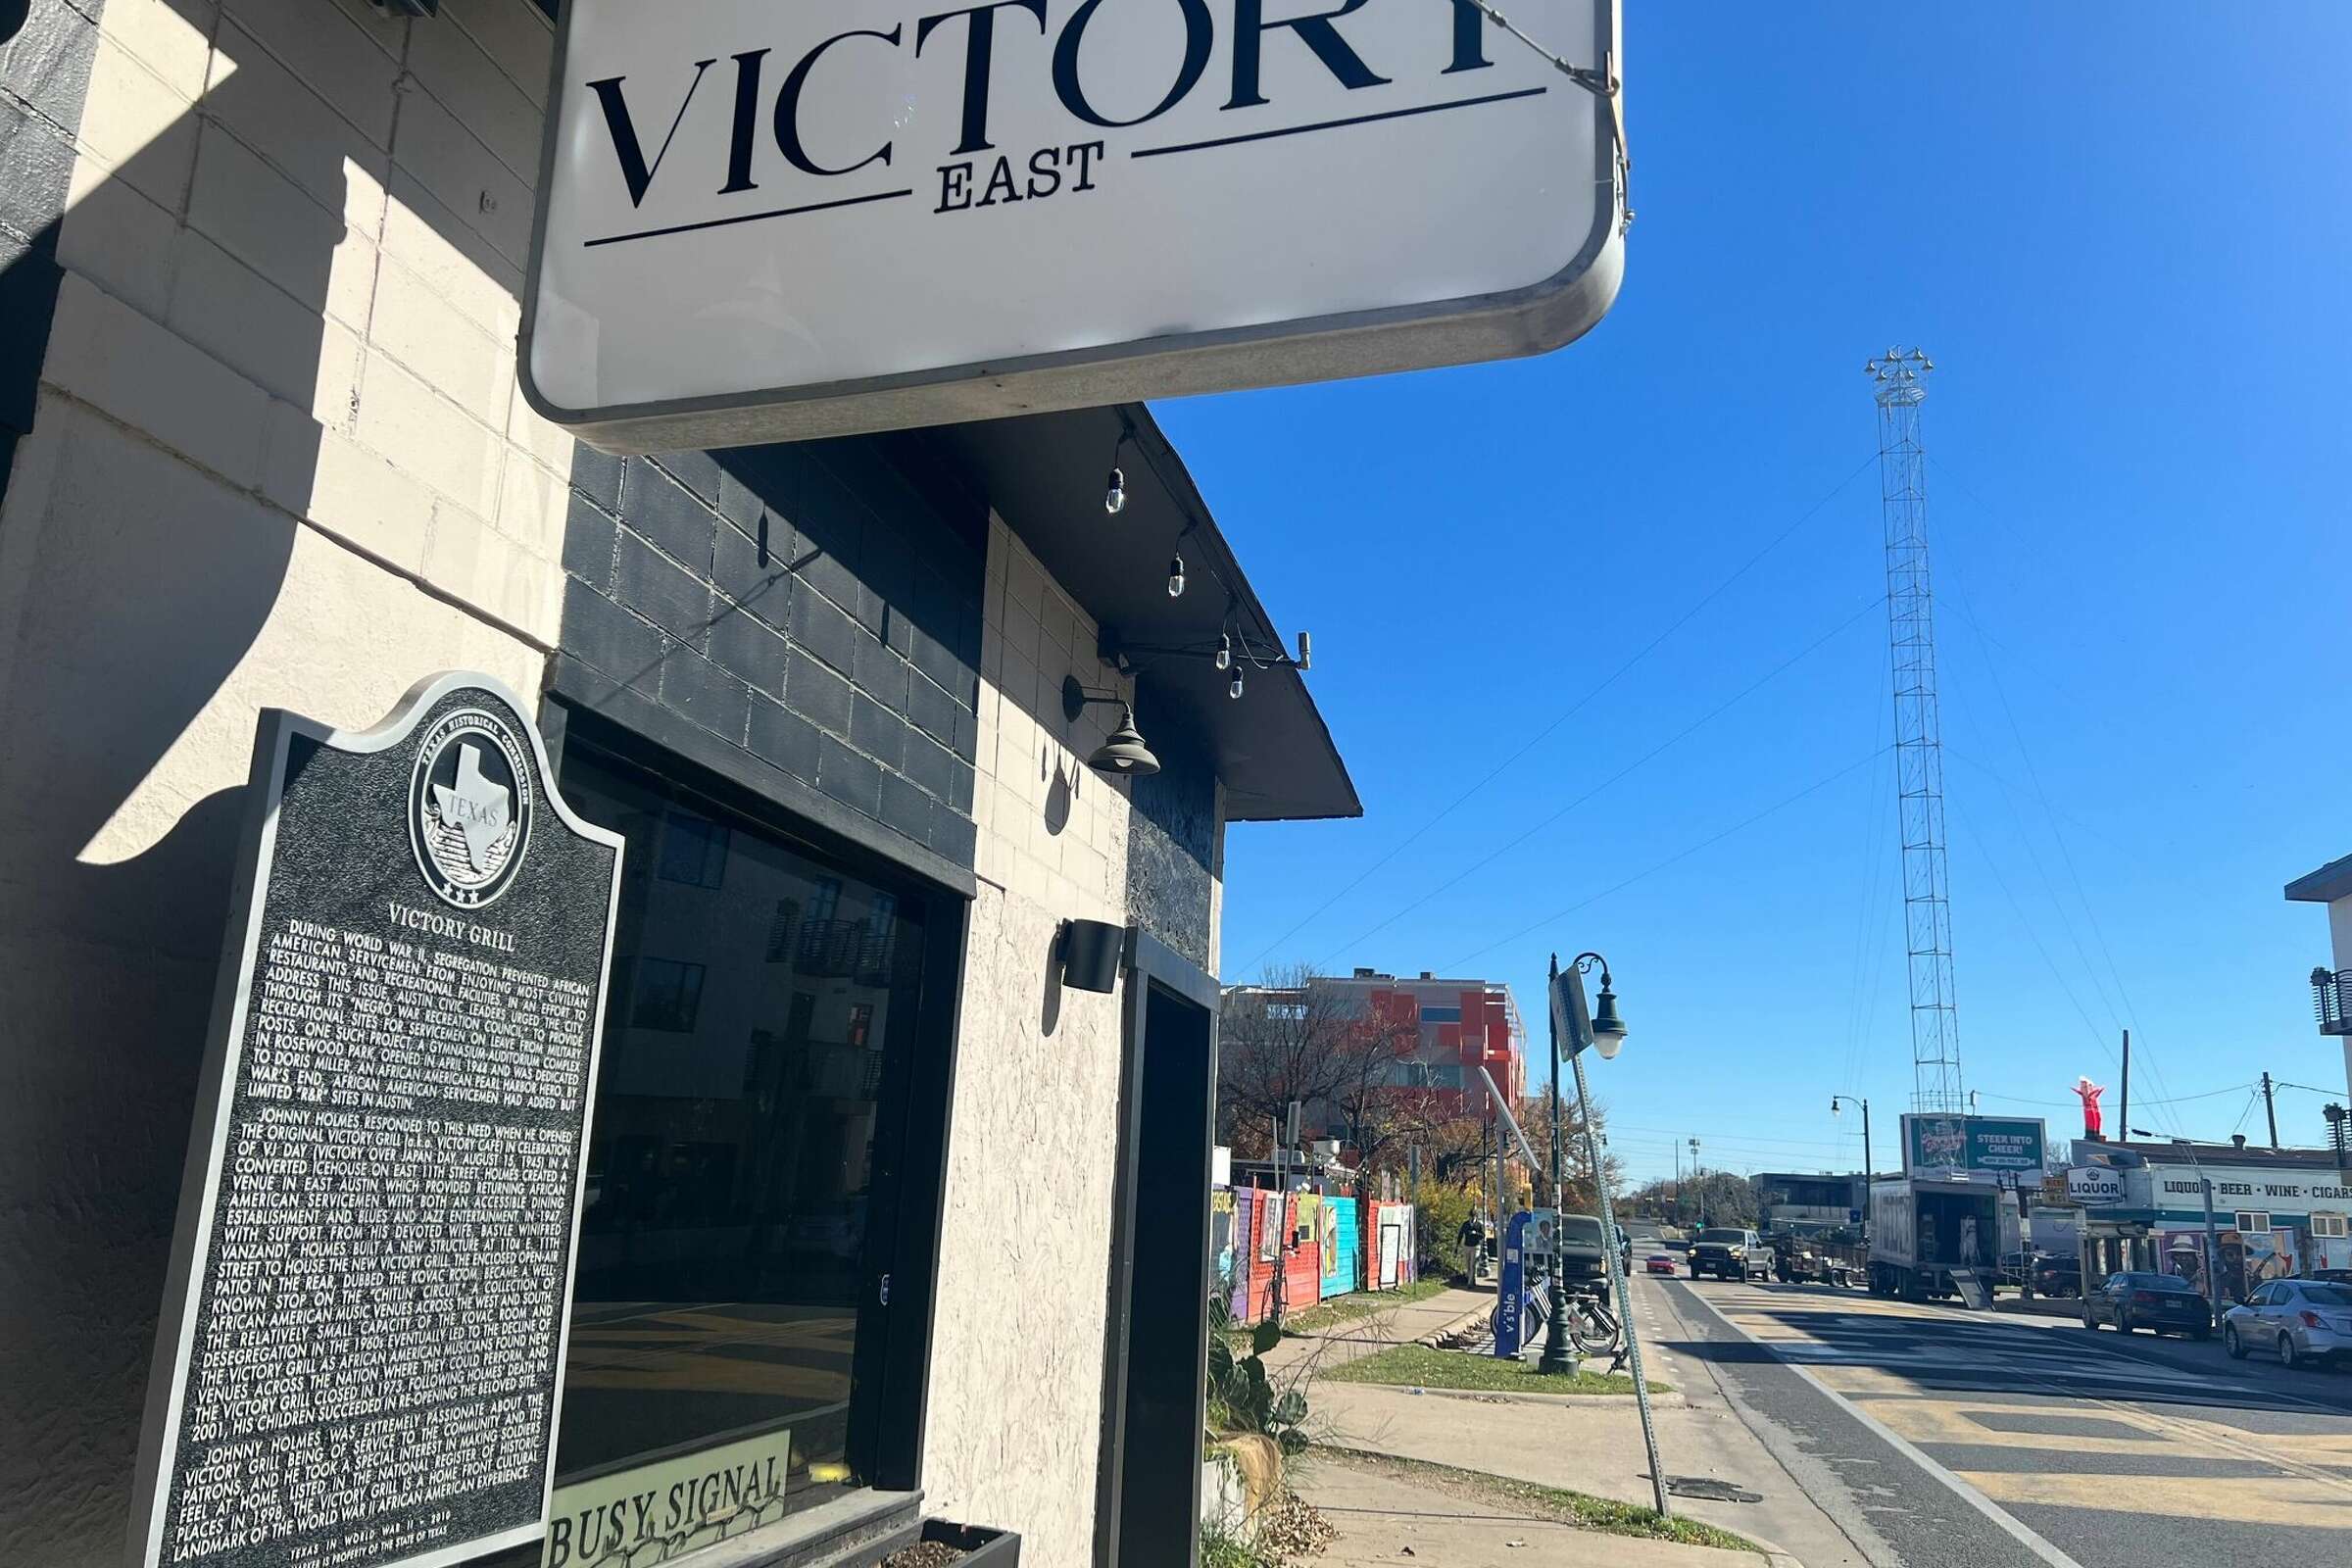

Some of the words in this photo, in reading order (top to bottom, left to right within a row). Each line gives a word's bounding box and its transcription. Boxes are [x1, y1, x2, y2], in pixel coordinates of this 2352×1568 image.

[933, 141, 1104, 216] EAST
[421, 728, 447, 765] TEXAS
[448, 714, 499, 736] HISTORICAL
[501, 734, 529, 806] COMMISSION
[448, 795, 500, 828] TEXAS
[287, 920, 337, 945] DURING
[341, 932, 383, 954] WORLD
[387, 942, 413, 959] WAR
[416, 948, 430, 965] II,
[432, 951, 498, 977] SEGREGATION
[501, 965, 549, 987] PREVENTED
[552, 976, 590, 995] AFRICAN
[389, 904, 466, 940] VICTORY
[469, 925, 516, 953] GRILL
[268, 951, 347, 978] RESTAURANTS
[353, 966, 378, 984] AND
[383, 972, 453, 997] RECREATIONAL
[457, 986, 503, 1005] FACILITIES.
[507, 995, 518, 1008] IN
[522, 998, 537, 1011] AN
[540, 1001, 569, 1017] EFFORT
[573, 1007, 587, 1020] TO
[270, 933, 341, 960] AMERICAN
[347, 949, 420, 975] SERVICEMEN
[425, 964, 456, 982] FROM
[461, 971, 512, 993] ENJOYING
[516, 982, 543, 999] MOST
[547, 988, 589, 1007] CIVILIAN
[259, 1000, 345, 1025] RECREATIONAL
[350, 1012, 378, 1030] SITES
[382, 1017, 404, 1034] FOR
[408, 1021, 466, 1042] SERVICEMEN
[469, 1031, 486, 1045] ON
[489, 1034, 514, 1049] LEAVE
[518, 1038, 543, 1053] FROM
[547, 1042, 582, 1058] MILITARY
[295, 1070, 327, 1090] END,
[331, 1074, 380, 1092] AFRICAN
[385, 1080, 438, 1098] AMERICAN
[442, 1085, 500, 1102] SERVICEMEN
[502, 1092, 523, 1105] HAD
[527, 1094, 557, 1108] ADDED
[560, 1098, 576, 1110] BUT
[228, 1193, 300, 1207] AMERICAN
[306, 1194, 380, 1207] SERVICEMEN
[385, 1195, 415, 1207] WITH
[418, 1195, 448, 1207] BOTH
[453, 1196, 468, 1207] AN
[473, 1196, 526, 1207] ACCESSIBLE
[530, 1197, 564, 1207] DINING
[231, 1176, 274, 1191] VENUE
[280, 1177, 297, 1191] IN
[303, 1177, 332, 1192] EAST
[338, 1178, 379, 1193] AUSTIN
[384, 1179, 419, 1193] WHICH
[423, 1180, 471, 1194] PROVIDED
[475, 1181, 525, 1194] RETURNING
[529, 1183, 566, 1195] AFRICAN
[2070, 1182, 2120, 1196] LIQUOR
[2164, 1181, 2205, 1194] LIQUO
[2220, 1184, 2253, 1196] BEER
[2265, 1185, 2300, 1198] WINE
[222, 1227, 260, 1243] WITH
[267, 1226, 322, 1242] SUPPORT
[328, 1225, 364, 1240] FROM
[368, 1225, 389, 1239] HIS
[393, 1224, 443, 1238] DEVOTED
[447, 1224, 475, 1239] WIFE,
[479, 1223, 514, 1236] BASYLE
[224, 1210, 319, 1225] ESTABLISHMENT
[325, 1210, 353, 1224] AND
[357, 1210, 388, 1223] BLUES
[393, 1210, 416, 1223] AND
[421, 1210, 444, 1222] JAZZ
[523, 1209, 535, 1221] IN
[539, 1209, 563, 1223] 1947,
[205, 1333, 230, 1349] THE
[238, 1326, 309, 1347] RELATIVELY
[316, 1322, 353, 1339] SMALL
[359, 1317, 411, 1335] CAPACITY
[416, 1315, 431, 1329] OF
[437, 1313, 456, 1327] THE
[460, 1310, 493, 1325] KOVAC
[498, 1307, 527, 1321] ROOM
[531, 1304, 554, 1318] AND
[196, 1383, 249, 1404] VENUES
[254, 1376, 305, 1396] ACROSS
[309, 1373, 331, 1390] THE
[334, 1367, 379, 1386] NATION
[382, 1362, 418, 1380] WHERE
[421, 1358, 445, 1374] THEY
[448, 1354, 480, 1371] COULD
[482, 1348, 525, 1368] PERFORM,
[528, 1346, 549, 1360] AND
[190, 1421, 228, 1445] 2001,
[230, 1417, 255, 1435] HIS
[255, 1408, 316, 1431] CHILDREN
[317, 1398, 382, 1421] SUCCEEDED
[382, 1396, 397, 1411] IN
[397, 1387, 458, 1408] RE-OPENING
[459, 1384, 475, 1398] THE
[476, 1378, 516, 1396] BELOVED
[517, 1375, 538, 1390] SITE.
[204, 1440, 263, 1464] JOHNNY
[269, 1430, 321, 1453] HOLMES
[327, 1424, 357, 1443] WAS
[362, 1414, 420, 1437] EXTREMELY
[425, 1403, 484, 1426] PASSIONATE
[489, 1396, 521, 1414] ABOUT
[526, 1394, 544, 1407] THE
[179, 1478, 246, 1508] PATRONS,
[249, 1471, 280, 1492] AND
[282, 1467, 300, 1485] HE
[304, 1460, 338, 1481] TOOK
[340, 1457, 351, 1473] A
[354, 1449, 395, 1471] SPECIAL
[398, 1440, 442, 1462] INTEREST
[444, 1437, 457, 1452] IN
[459, 1429, 498, 1449] MAKING
[500, 1421, 541, 1442] SOLDIERS
[172, 1530, 247, 1562] LANDMARK
[248, 1525, 269, 1544] OF
[270, 1519, 294, 1539] THE
[295, 1509, 339, 1533] WORLD
[339, 1502, 367, 1522] WAR
[367, 1500, 376, 1515] II
[376, 1490, 423, 1513] AFRICAN
[423, 1478, 475, 1502] AMERICAN
[475, 1465, 531, 1490] EXPERIENCE.
[174, 1517, 225, 1544] PLACES
[228, 1512, 247, 1531] IN
[251, 1503, 287, 1529] 1998,
[292, 1497, 314, 1517] THE
[318, 1487, 366, 1511] VICTORY
[368, 1480, 397, 1499] GRILL
[401, 1477, 413, 1493] IS
[416, 1474, 424, 1489] A
[427, 1467, 457, 1486] HOME
[461, 1459, 492, 1479] FRONT
[495, 1449, 538, 1471] CULTURAL
[548, 1491, 657, 1568] BUSY
[665, 1456, 781, 1533] SIGNAL
